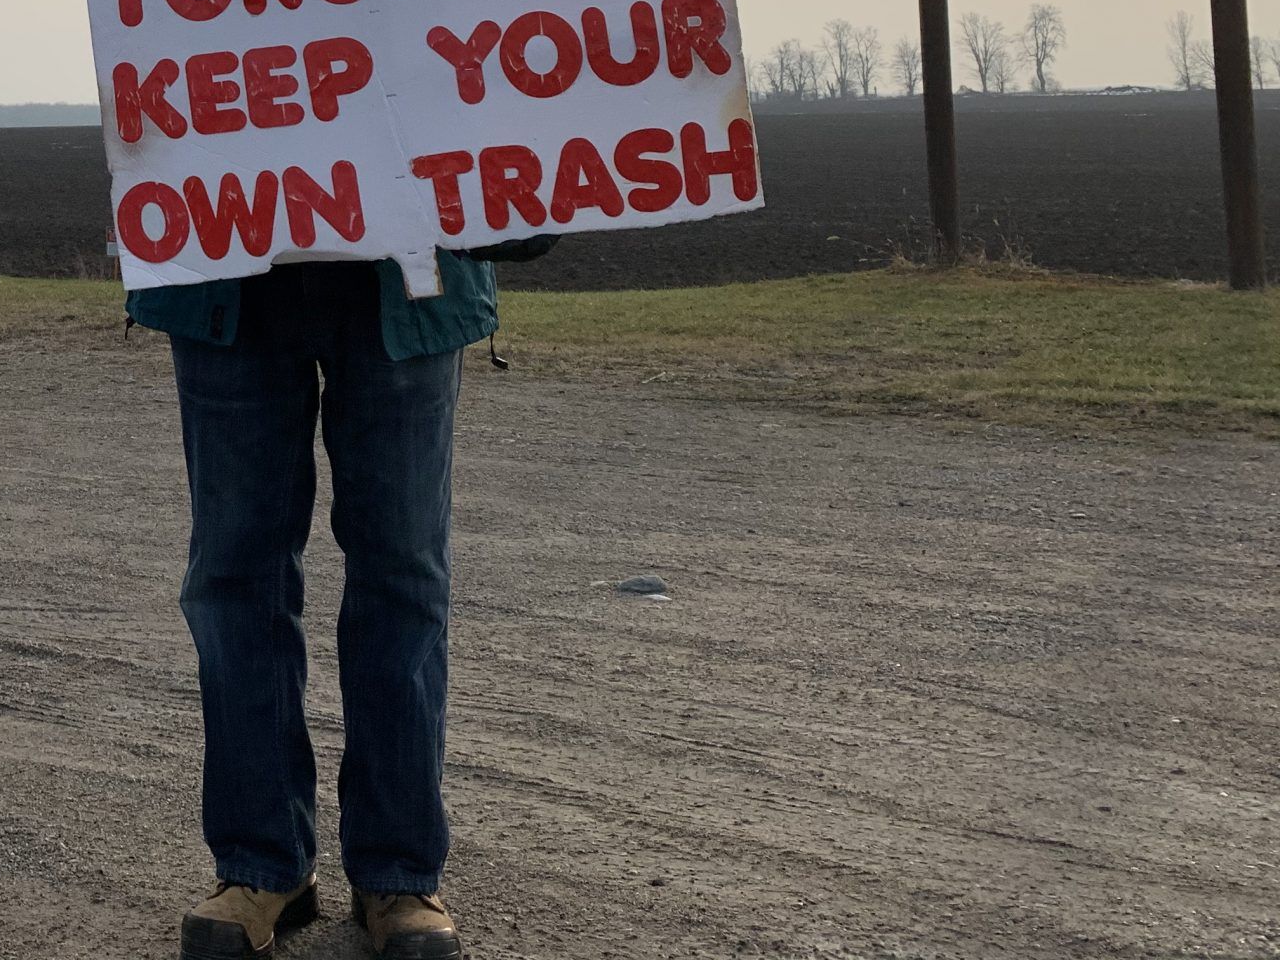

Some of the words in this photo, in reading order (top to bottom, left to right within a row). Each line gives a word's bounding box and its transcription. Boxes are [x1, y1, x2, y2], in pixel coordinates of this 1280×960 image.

[113, 36, 374, 143] KEEP
[117, 160, 365, 263] OWN
[411, 118, 757, 236] TRASH
